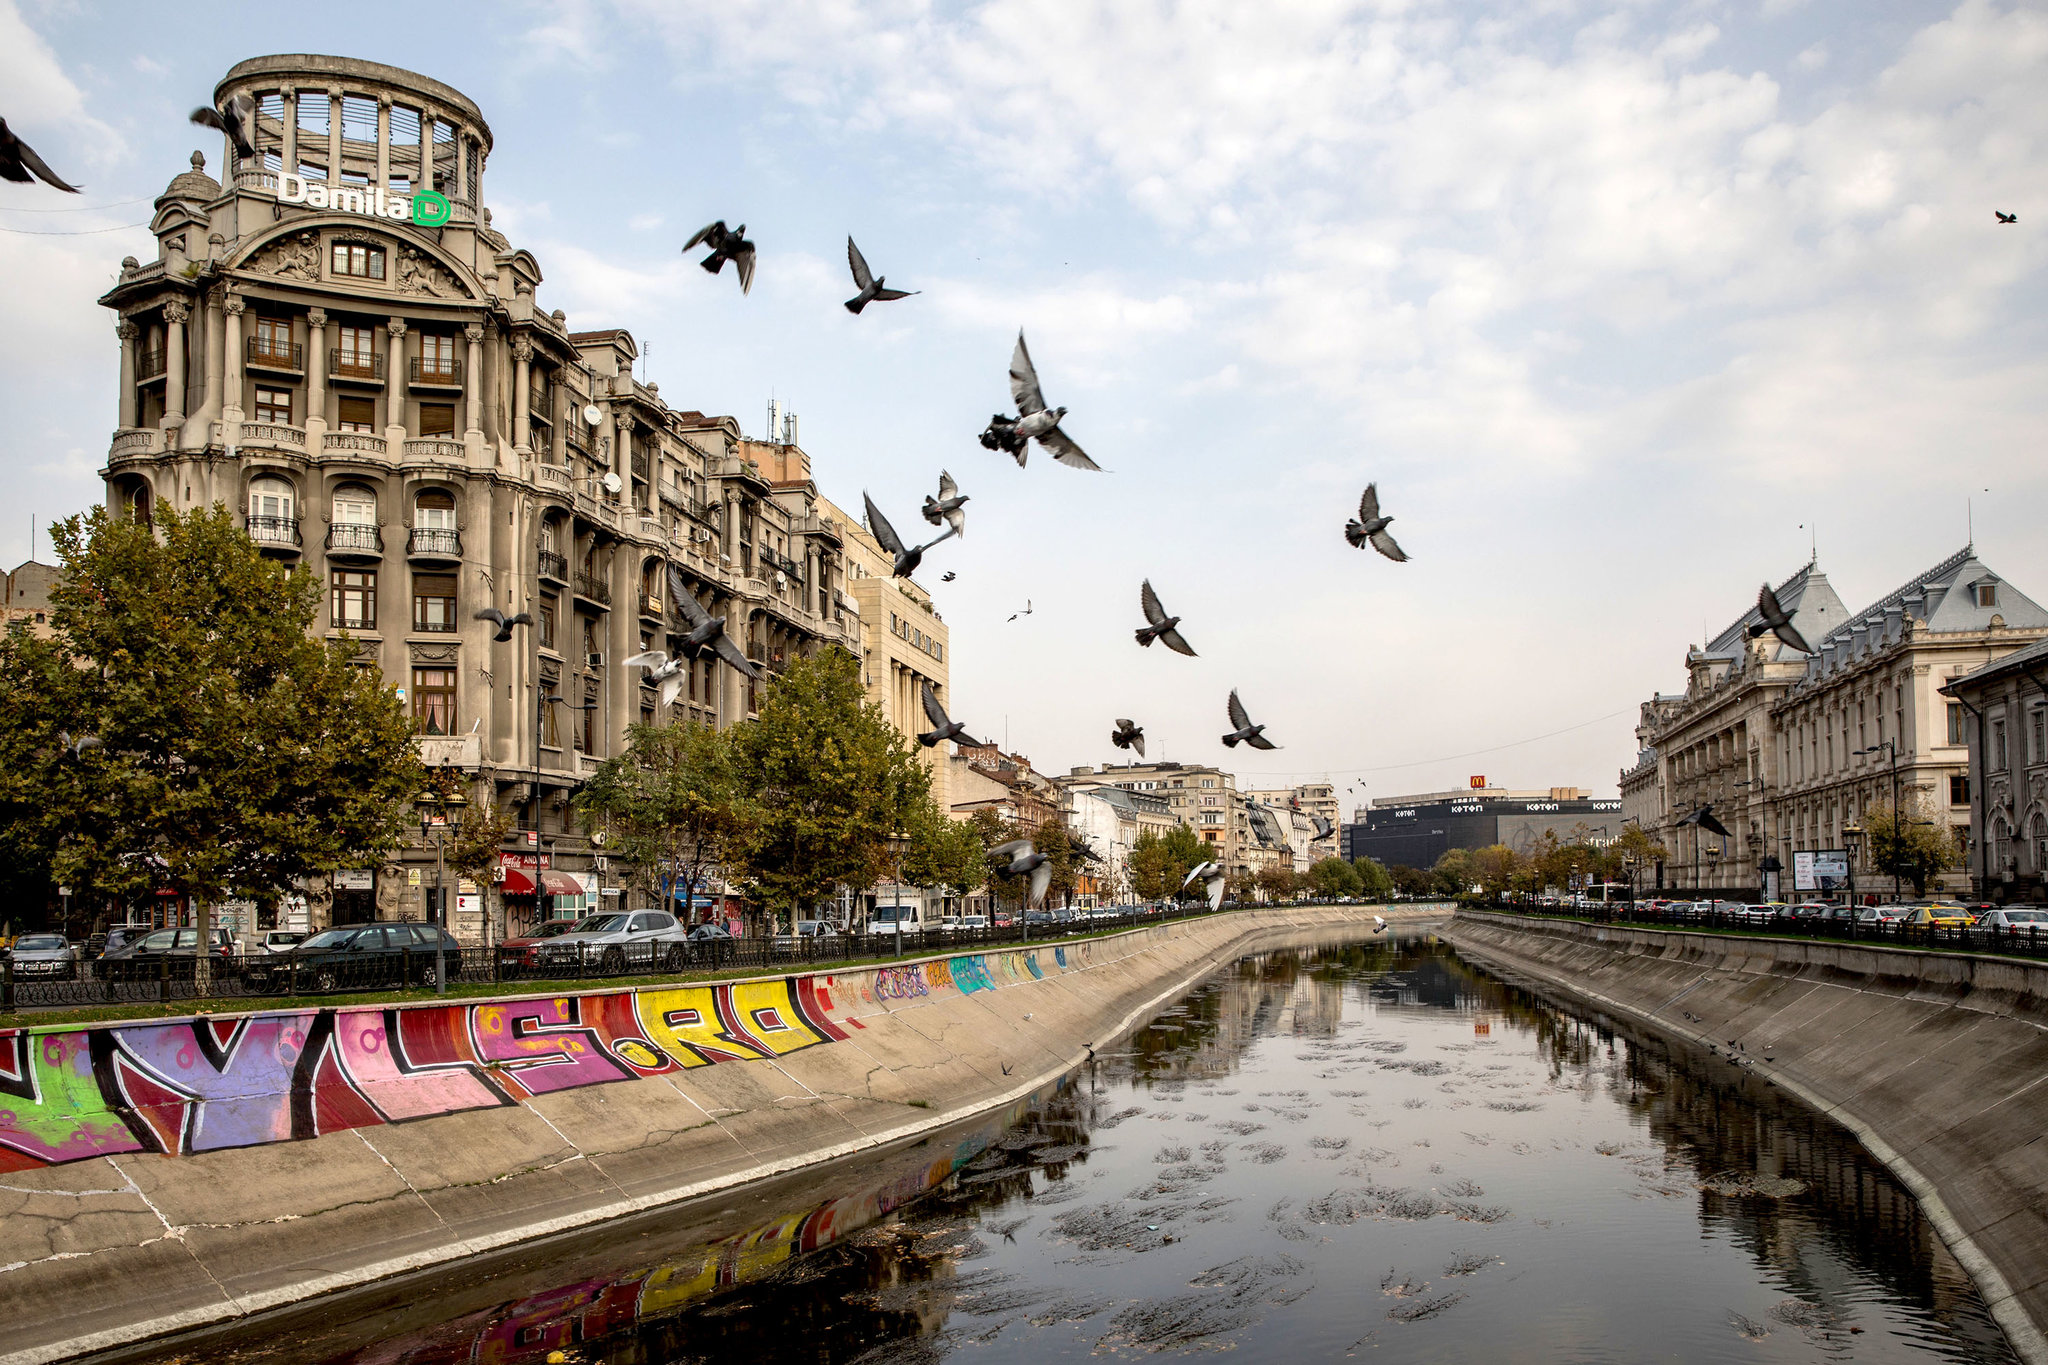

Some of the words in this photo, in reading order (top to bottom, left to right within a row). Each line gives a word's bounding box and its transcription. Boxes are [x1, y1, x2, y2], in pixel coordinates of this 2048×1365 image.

[277, 171, 409, 220] Damila
[1451, 804, 1483, 813] KOTON
[1526, 803, 1559, 811] KOTON
[1395, 809, 1416, 818] KOTON
[502, 854, 521, 868] Coca-Cola
[523, 855, 549, 865] ANDNA
